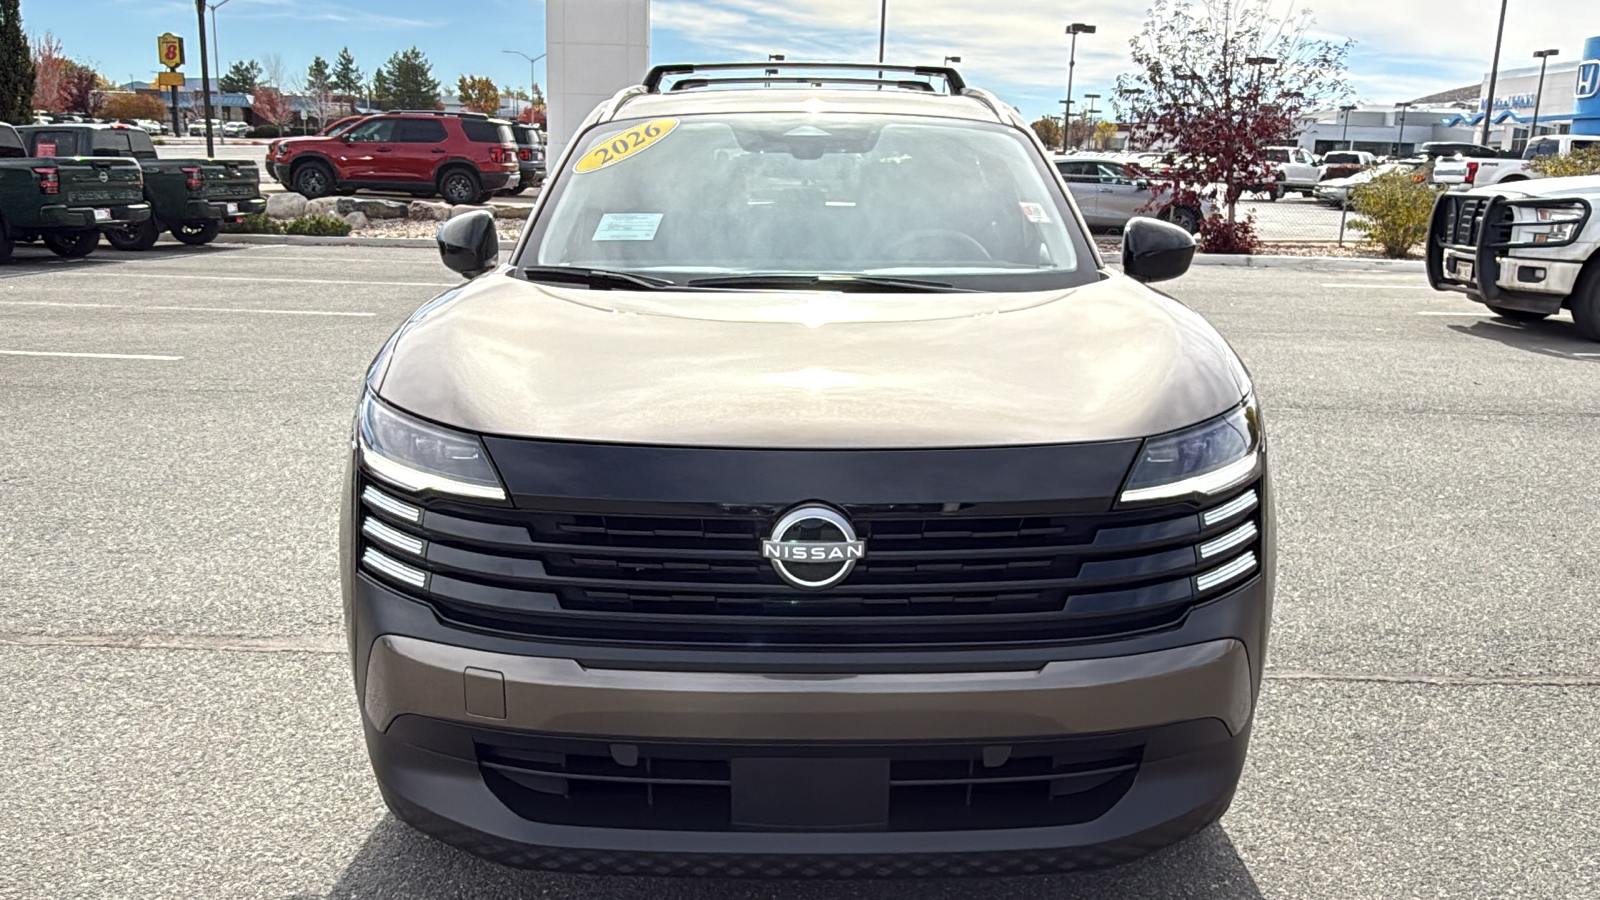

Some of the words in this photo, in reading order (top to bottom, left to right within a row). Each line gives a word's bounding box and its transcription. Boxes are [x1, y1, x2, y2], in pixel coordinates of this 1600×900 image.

[165, 44, 177, 60] 8
[594, 123, 660, 165] 2026
[765, 544, 862, 559] NISSAN
